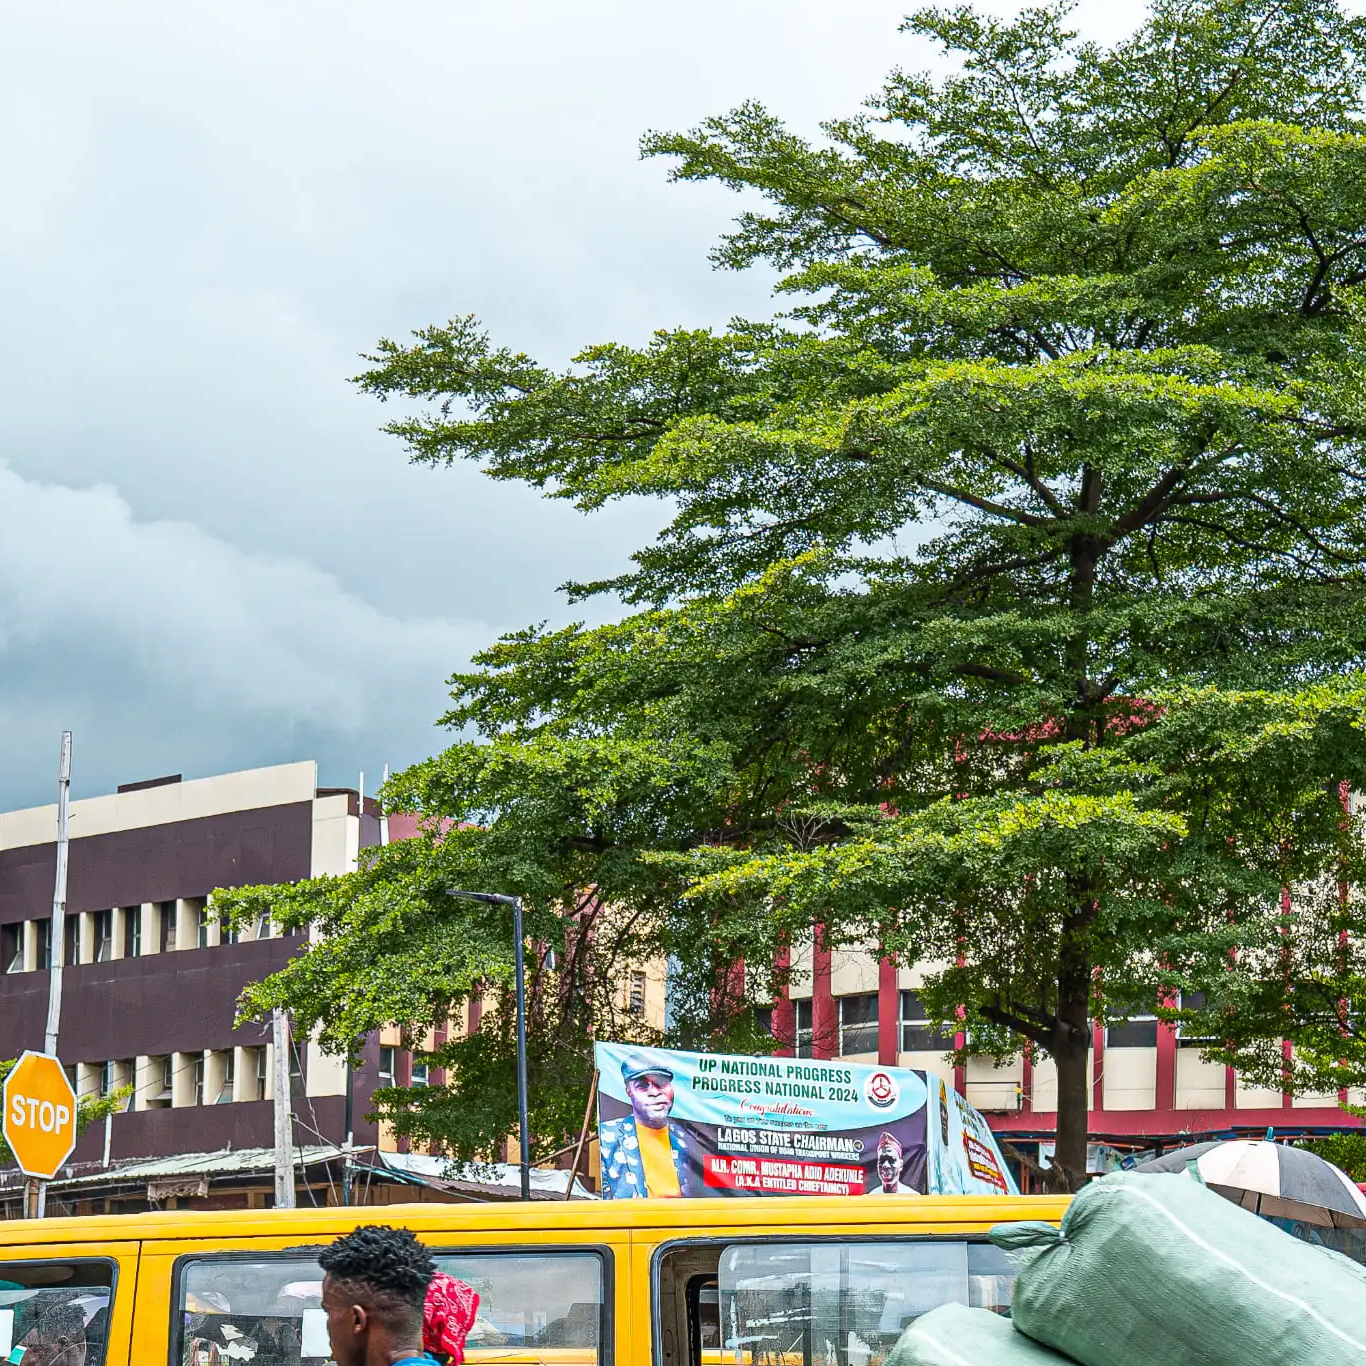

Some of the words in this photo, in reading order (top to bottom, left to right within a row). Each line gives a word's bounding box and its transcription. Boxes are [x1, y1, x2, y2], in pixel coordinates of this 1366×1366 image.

[699, 1058, 717, 1073] UP
[721, 1061, 783, 1078] NATIONAL
[786, 1066, 851, 1084] PROGRESS
[692, 1076, 761, 1094] PROGRESS
[765, 1082, 825, 1100] NATIONAL
[828, 1087, 859, 1103] 2024
[11, 1094, 70, 1134] STOP
[717, 1127, 757, 1144] LAGOS
[759, 1131, 791, 1147] STATE
[794, 1133, 854, 1152] CHAIRMAN
[718, 1141, 748, 1152] NATIONAL
[749, 1144, 769, 1154] UNION
[770, 1146, 778, 1154] OF
[831, 1151, 860, 1161] WORKERS
[731, 1159, 759, 1175] COMR.
[761, 1161, 802, 1179] MUSTAPHA
[804, 1165, 823, 1180] ADIO
[824, 1167, 864, 1183] ADEKUNLE
[735, 1175, 760, 1188] (A.K.A
[763, 1177, 796, 1191] ENTITLED
